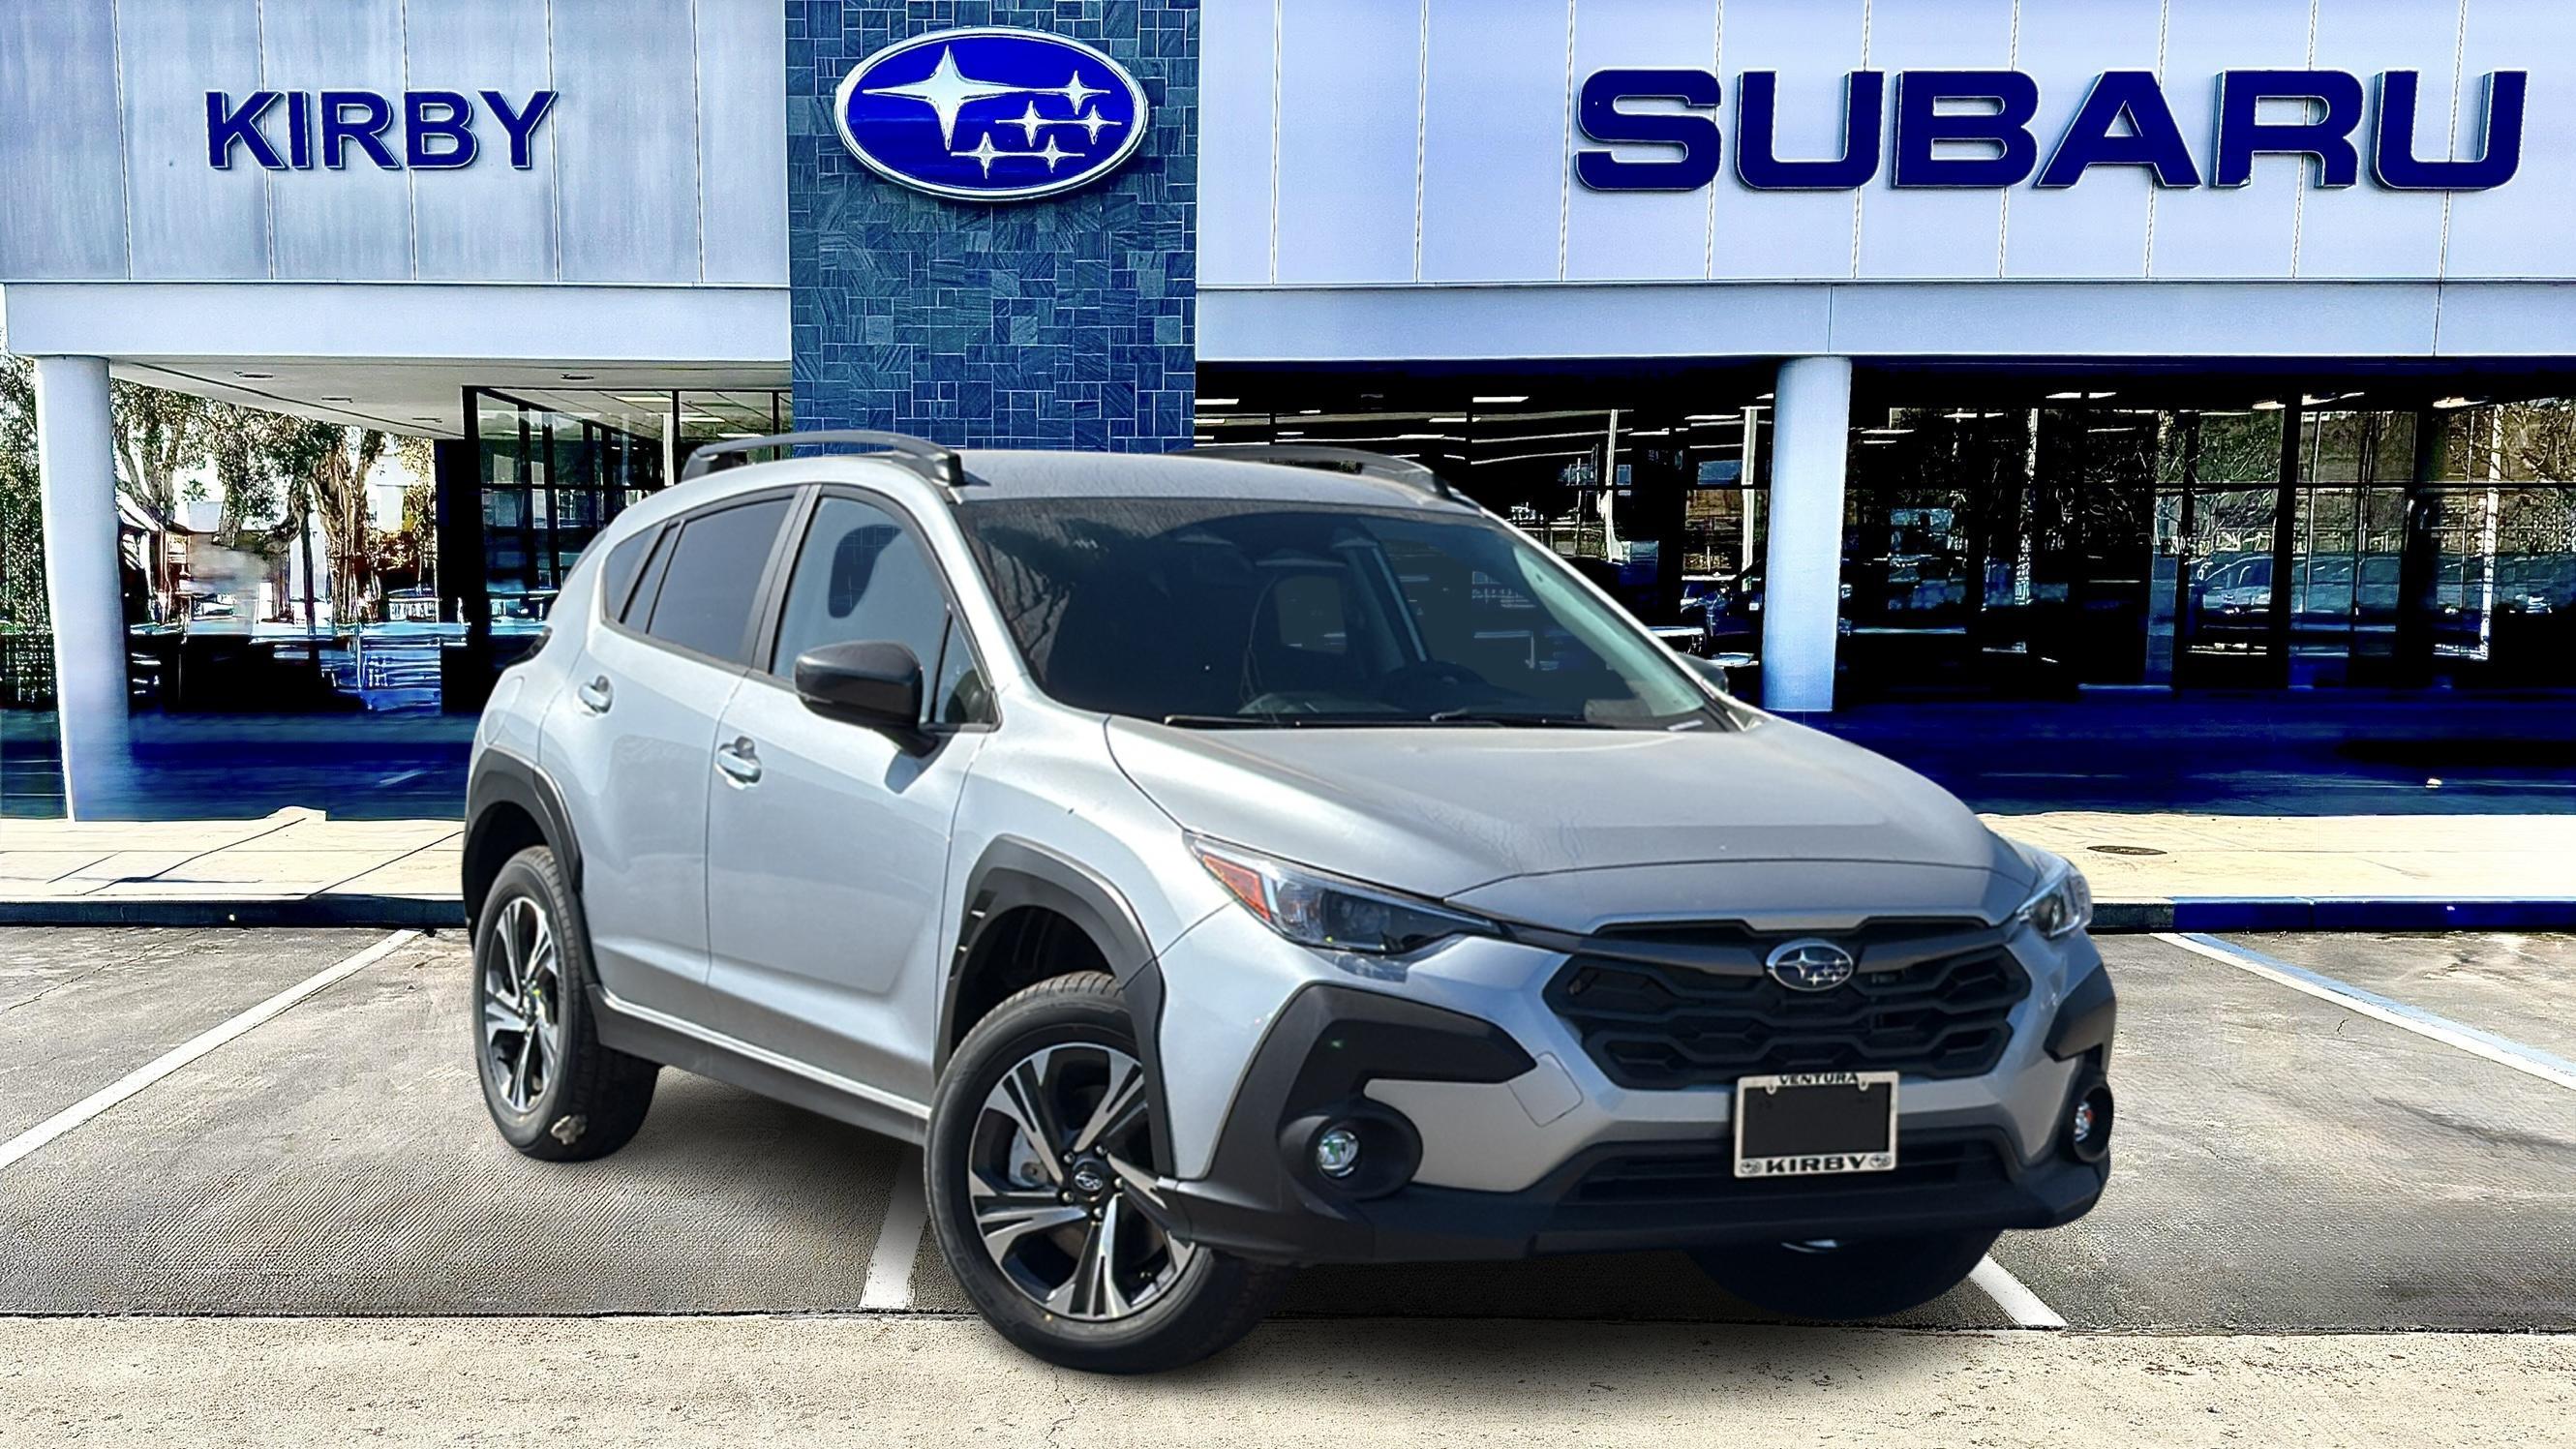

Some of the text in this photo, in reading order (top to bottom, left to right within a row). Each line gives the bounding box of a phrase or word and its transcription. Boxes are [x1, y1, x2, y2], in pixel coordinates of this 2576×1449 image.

[206, 90, 558, 169] KIRBY
[1576, 69, 2528, 192] SUBARU
[1779, 1072, 1859, 1085] VENTURA
[1766, 1155, 1866, 1173] KIRBY
